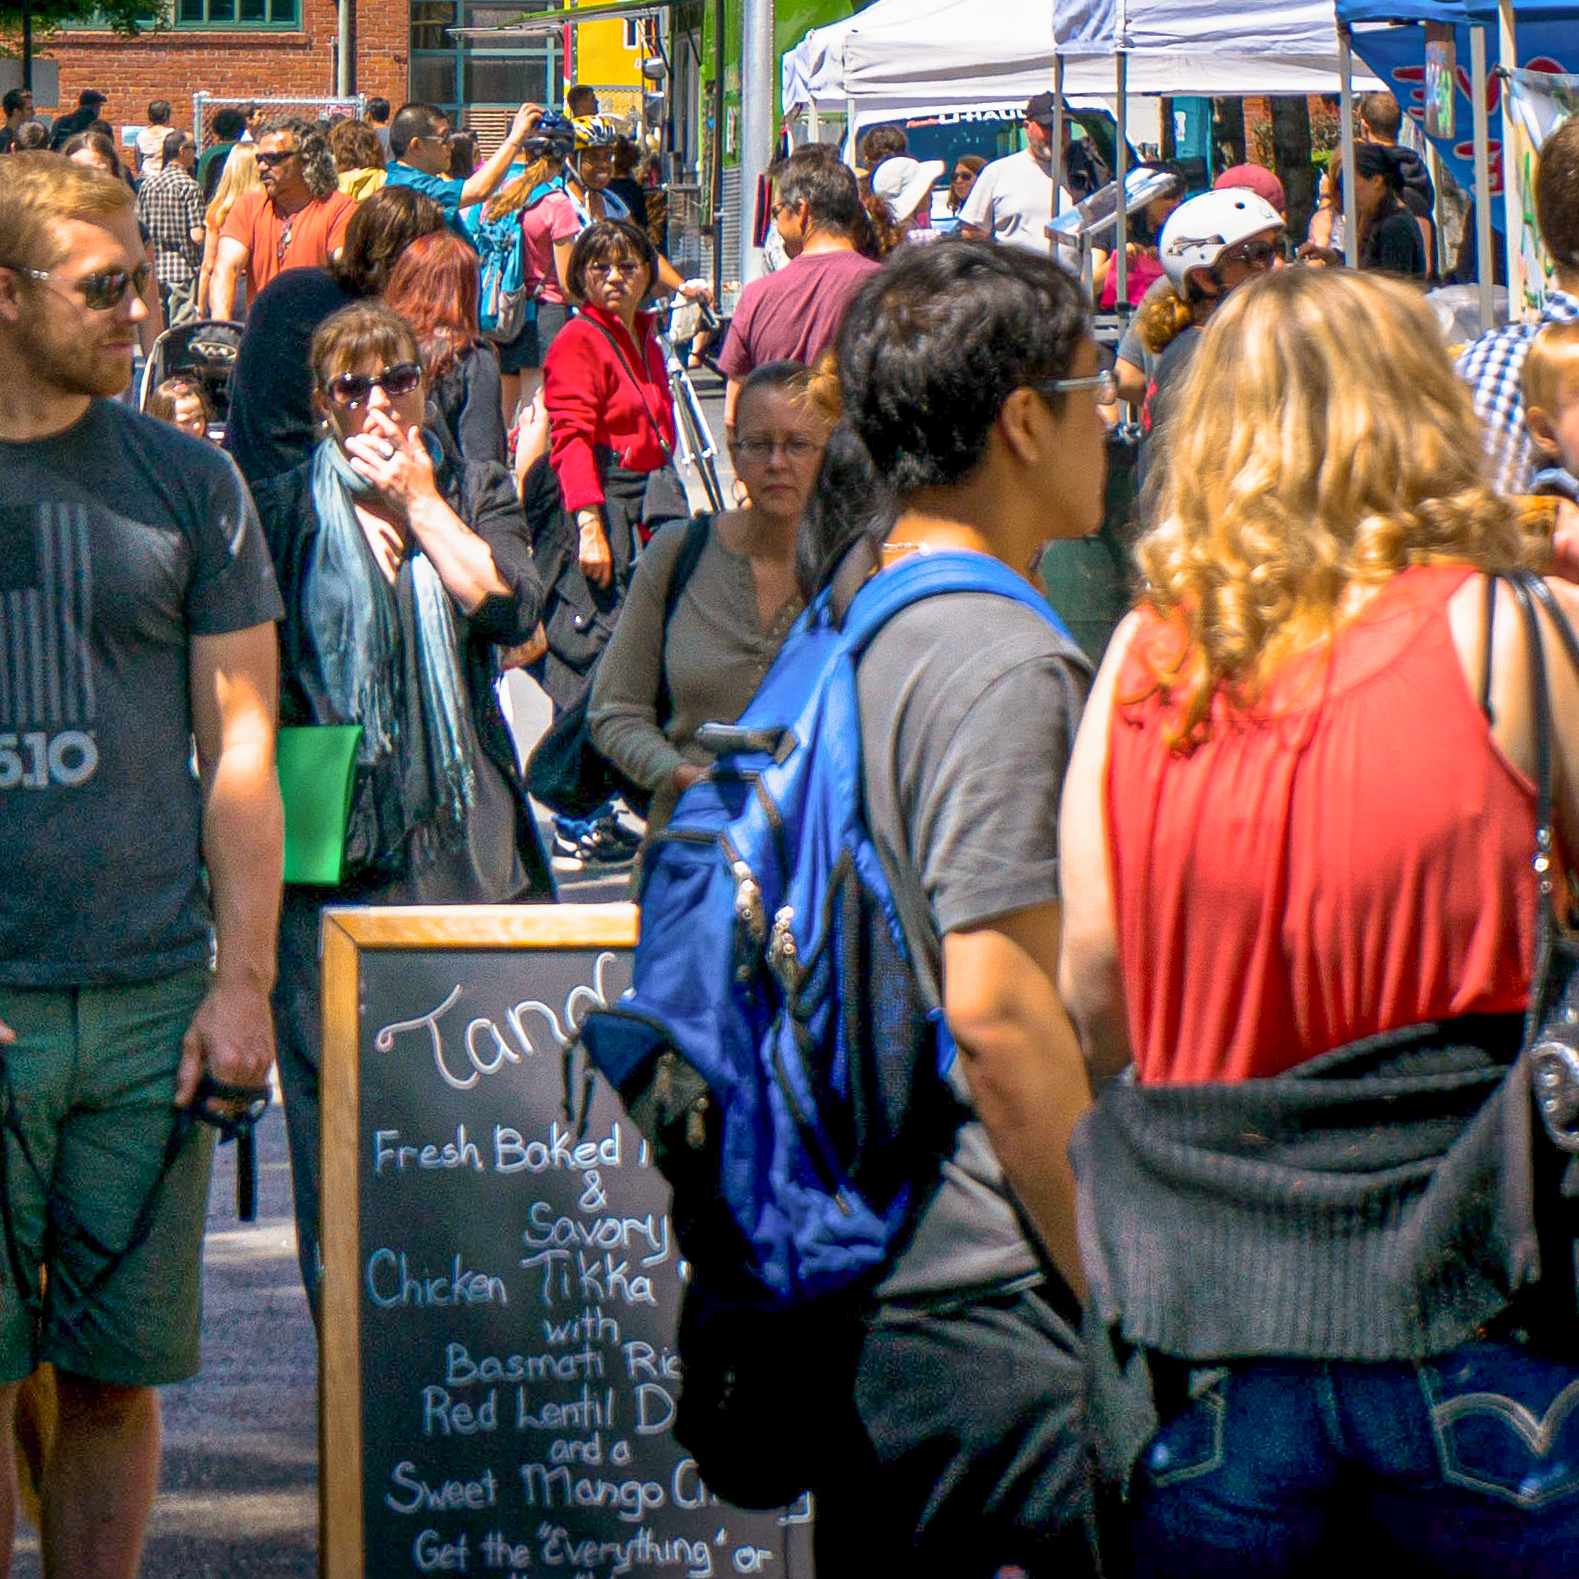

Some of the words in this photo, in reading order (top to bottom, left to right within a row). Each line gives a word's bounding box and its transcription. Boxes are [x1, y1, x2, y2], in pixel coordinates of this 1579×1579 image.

[375, 951, 637, 1090] Tand
[371, 1122, 485, 1176] Fresh
[493, 1120, 622, 1174] Baked
[578, 1168, 608, 1214] &
[522, 1200, 671, 1268] Savory
[365, 1247, 510, 1310] Chicken
[520, 1248, 659, 1308] Tikka
[542, 1305, 620, 1346] with
[444, 1340, 606, 1387] Basmati
[622, 1340, 684, 1382] Ric
[422, 1383, 499, 1437] Red
[517, 1382, 616, 1433] Lentil
[549, 1430, 603, 1466] and
[610, 1438, 632, 1467] a
[383, 1459, 500, 1515] Sweet
[520, 1462, 667, 1524] Mango
[414, 1528, 469, 1572] Get
[480, 1529, 533, 1569] the
[733, 1544, 775, 1574] or
